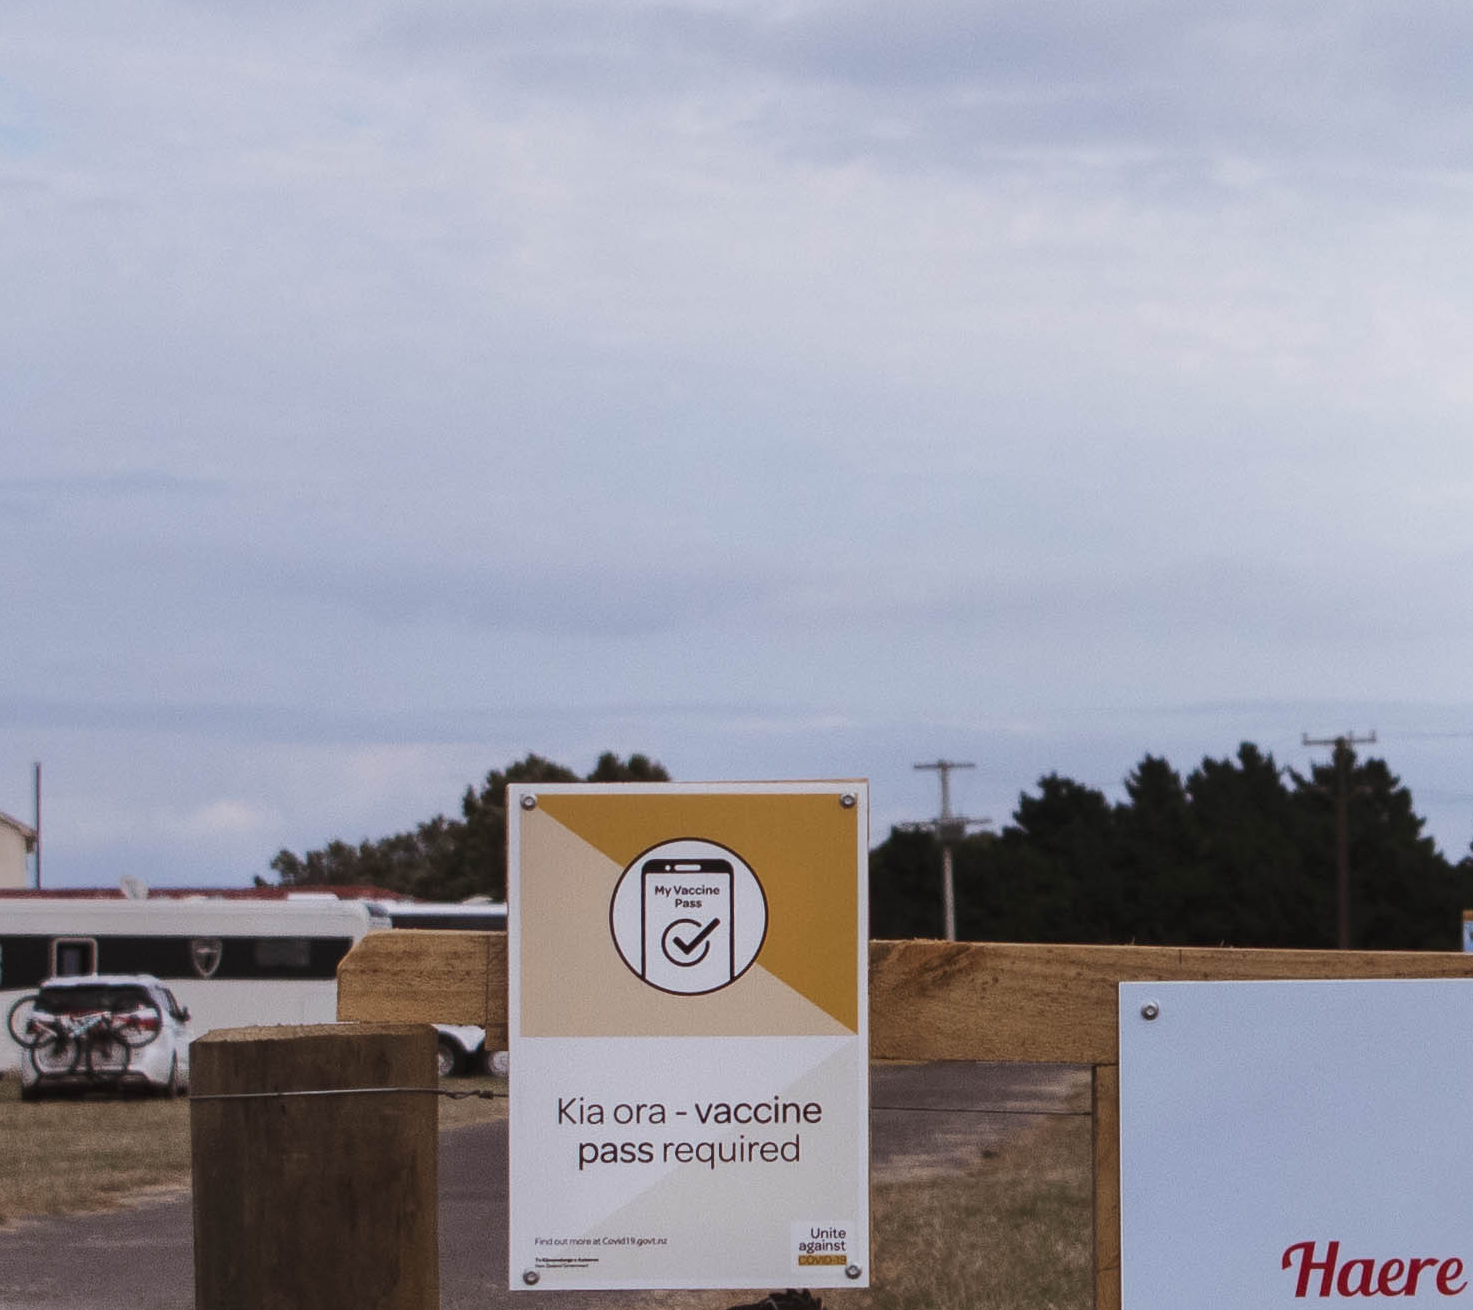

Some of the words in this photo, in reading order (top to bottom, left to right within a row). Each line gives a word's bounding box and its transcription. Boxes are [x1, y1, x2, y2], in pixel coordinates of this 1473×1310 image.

[654, 885, 672, 897] My
[673, 884, 720, 895] Vaccine
[674, 898, 703, 908] Pass
[558, 1096, 604, 1125] Kia
[613, 1103, 666, 1124] ora
[695, 1095, 823, 1124] vaccine
[579, 1141, 654, 1171] pass
[663, 1133, 800, 1170] required
[810, 1226, 847, 1239] Unite
[534, 1237, 553, 1246] Find
[569, 1238, 592, 1246] more
[798, 1239, 847, 1254] against
[1280, 1240, 1468, 1298] Haere
